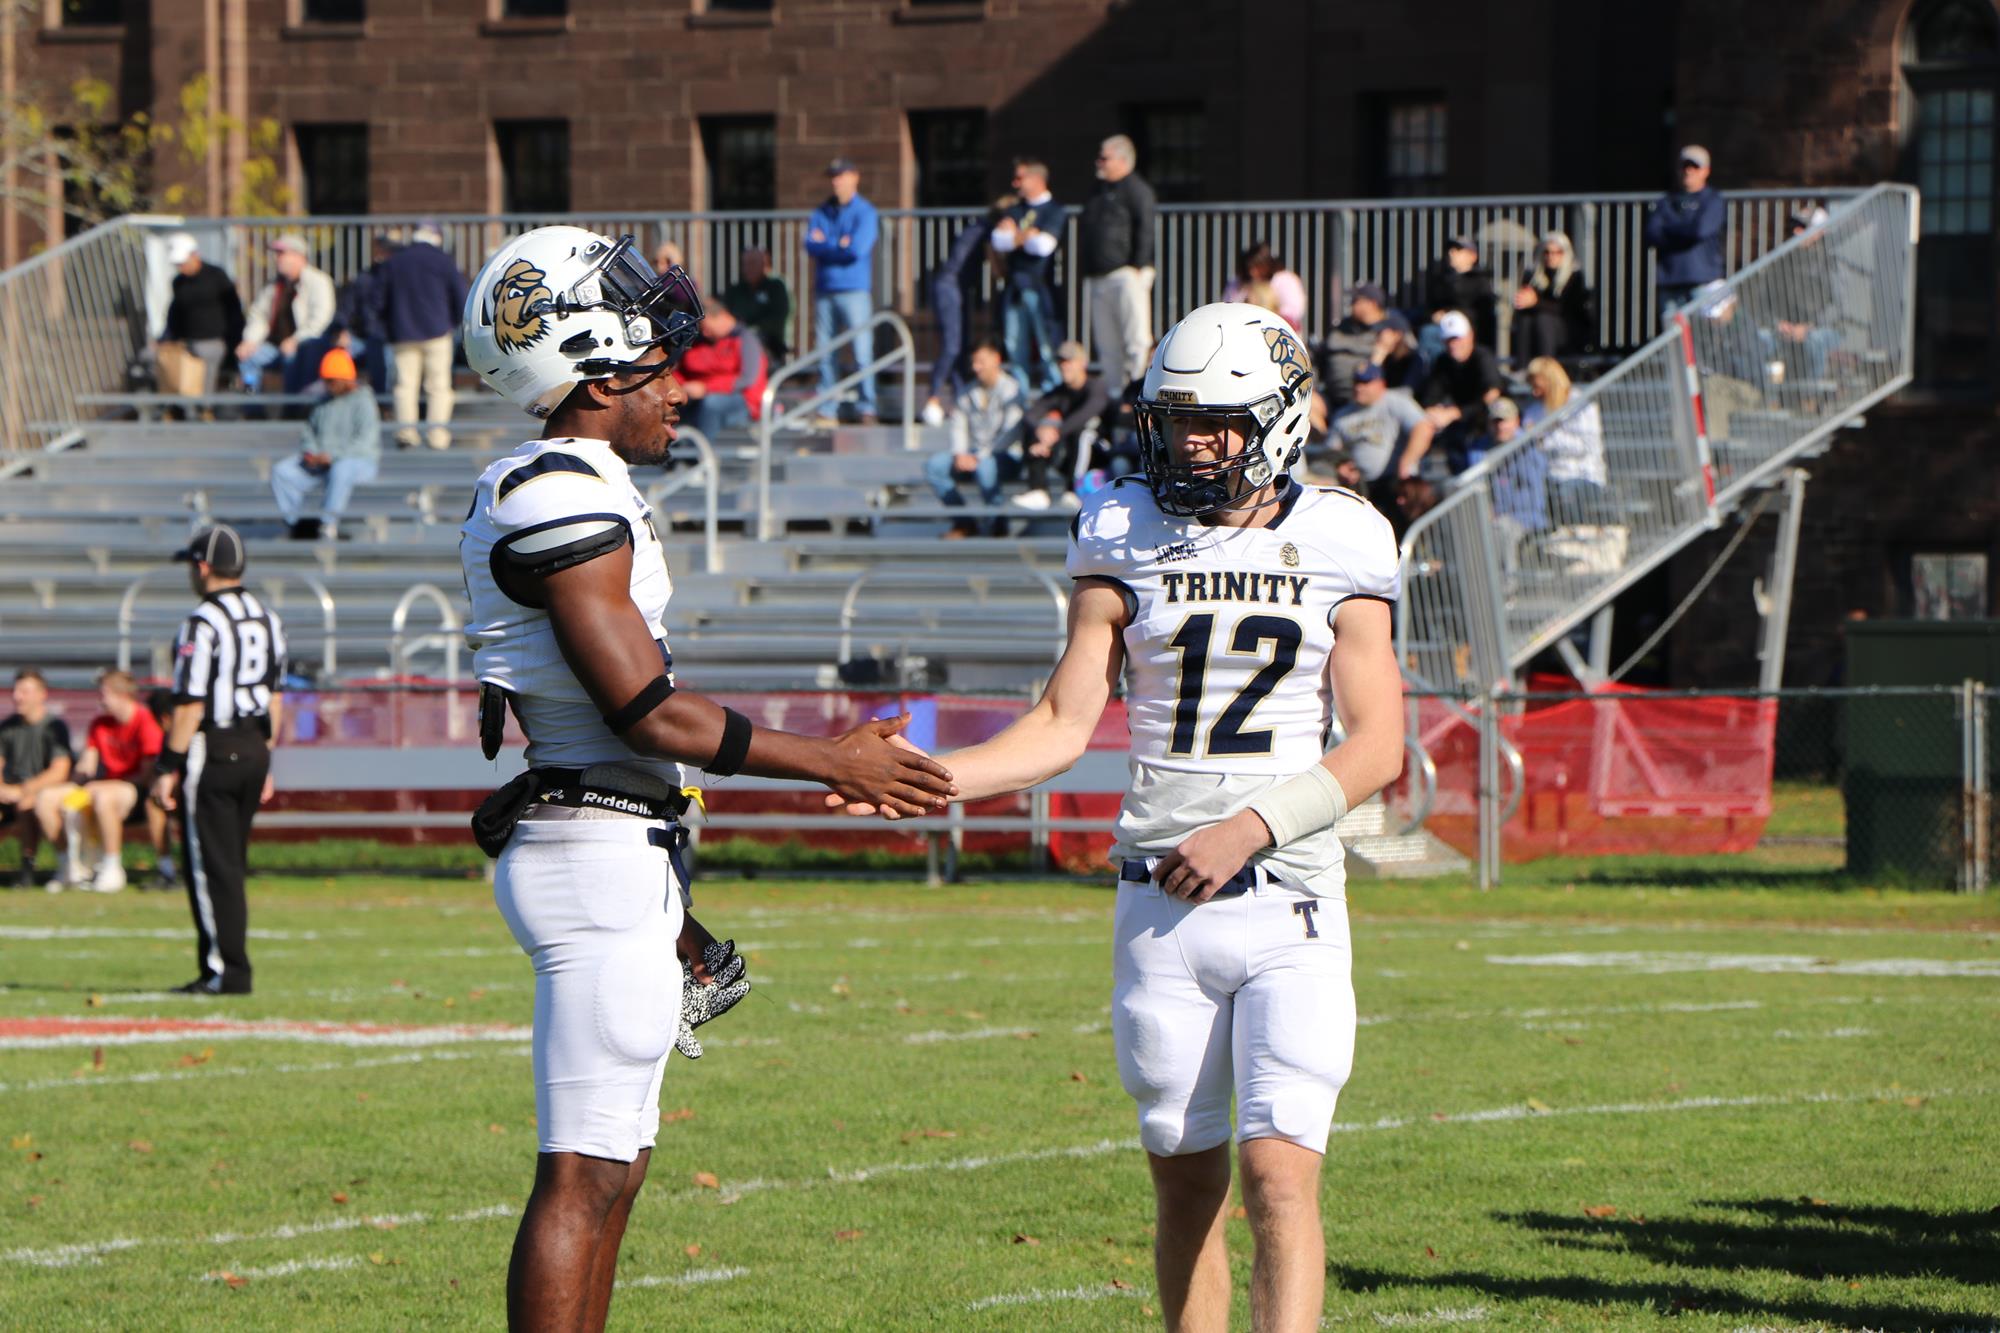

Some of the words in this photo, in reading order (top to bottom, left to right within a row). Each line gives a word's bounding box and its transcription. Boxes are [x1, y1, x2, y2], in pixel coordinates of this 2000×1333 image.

[1159, 390, 1194, 401] TRINITY
[1162, 572, 1309, 606] TRINITY
[237, 621, 269, 685] B
[1167, 610, 1304, 759] 12
[582, 792, 648, 815] Riddell
[1291, 900, 1319, 940] T
